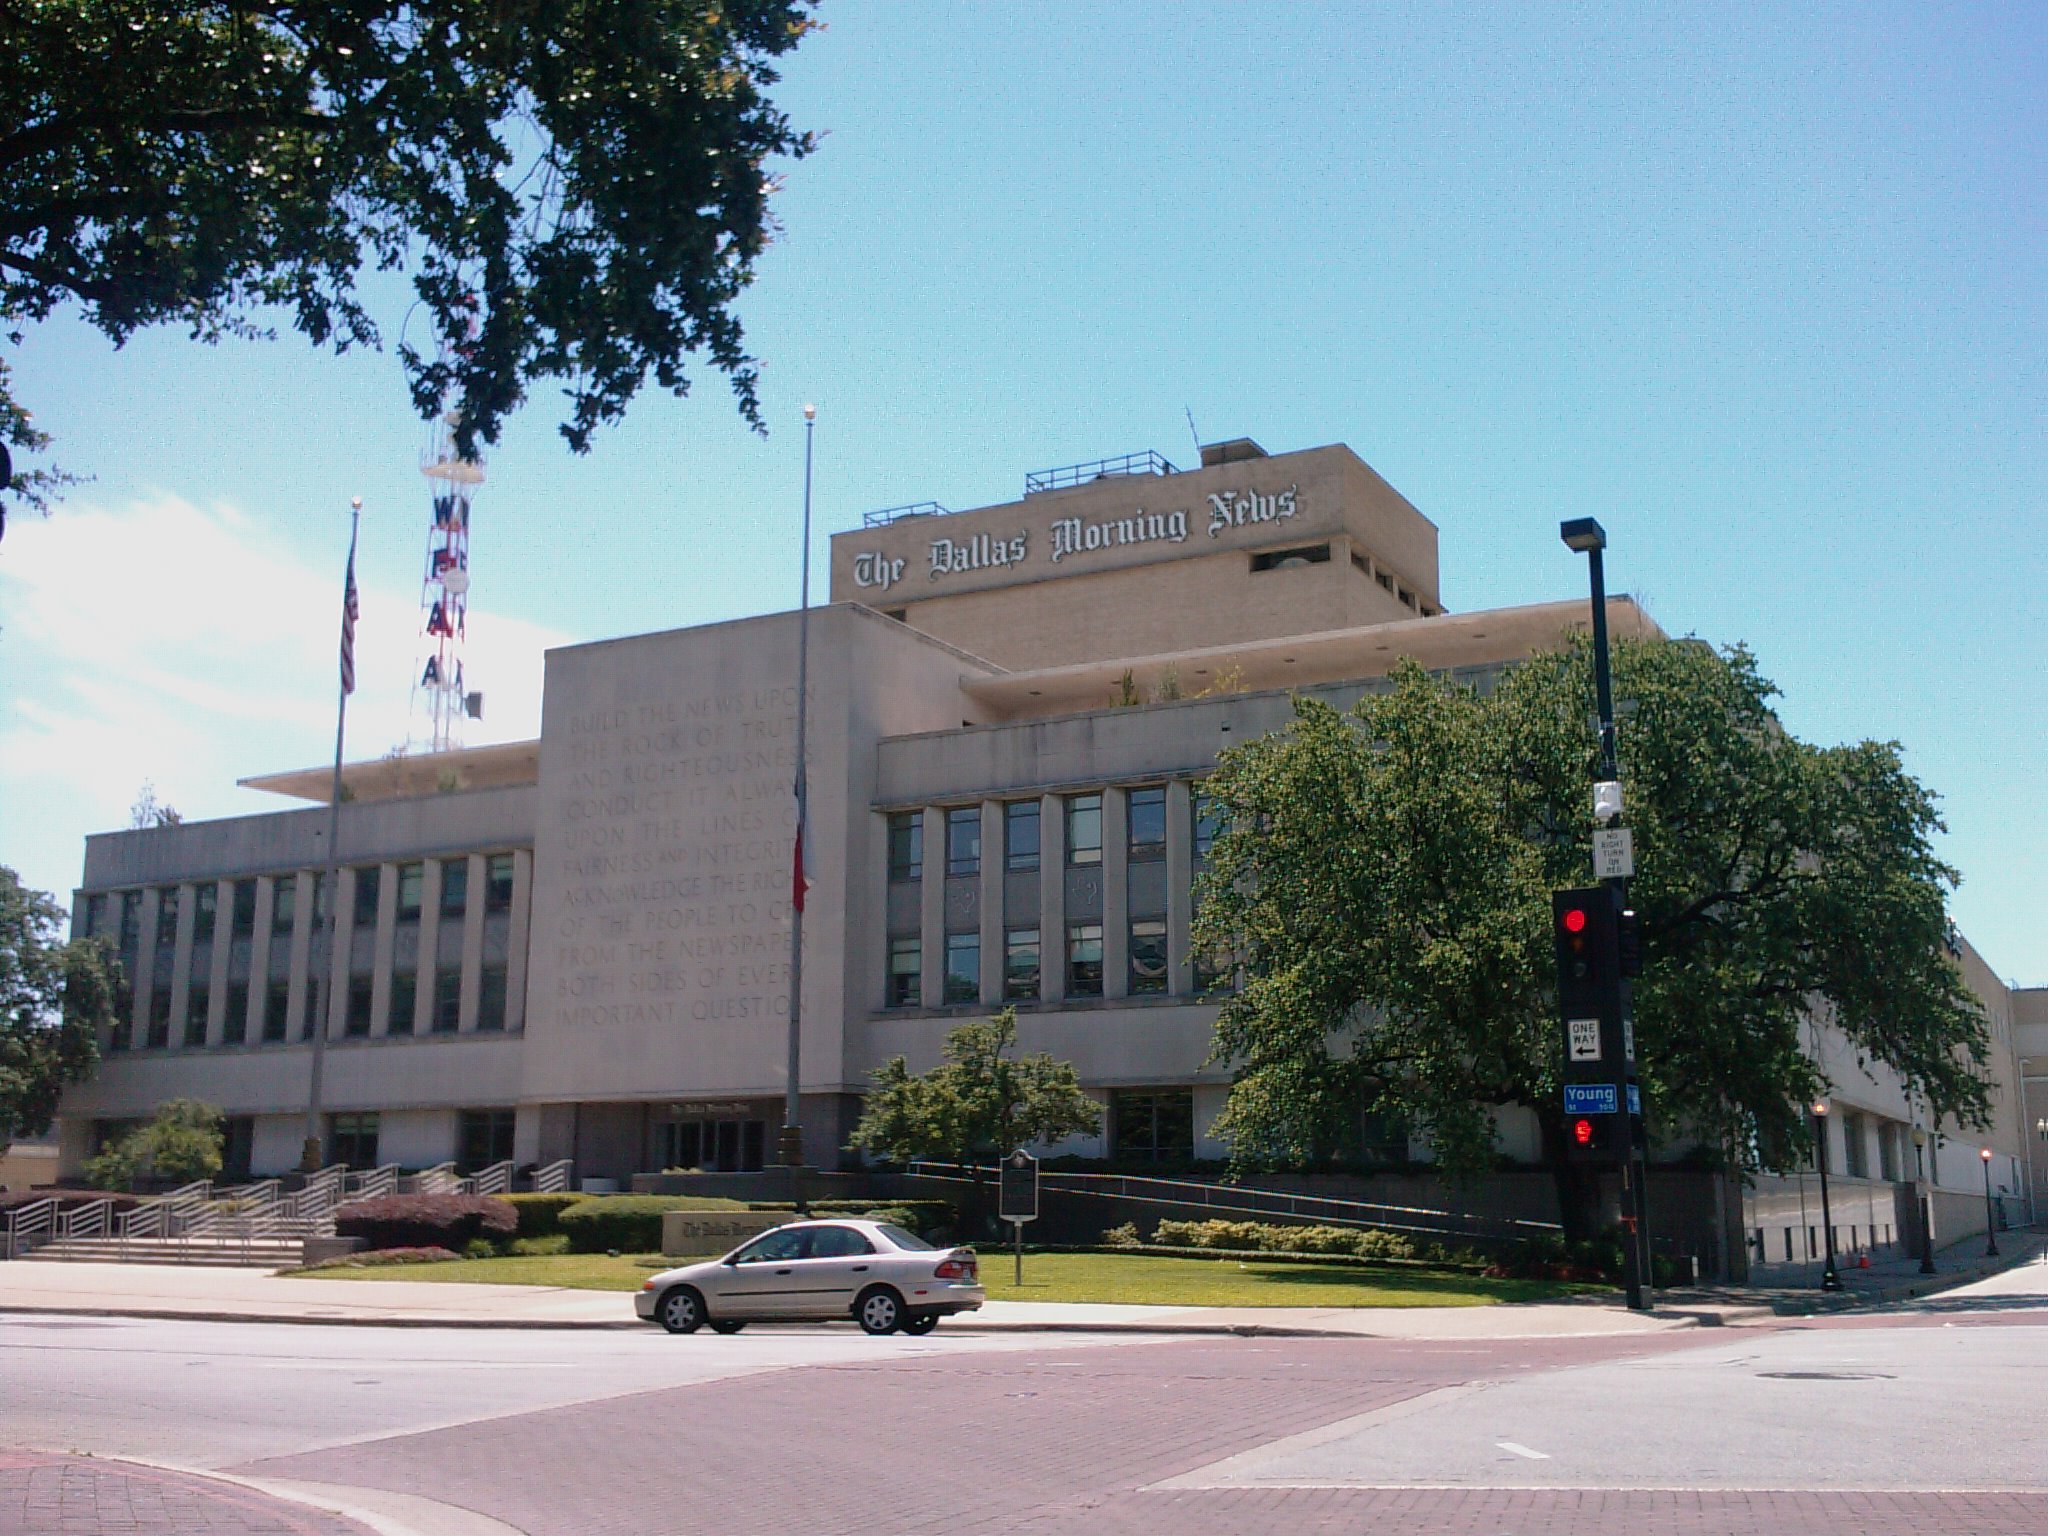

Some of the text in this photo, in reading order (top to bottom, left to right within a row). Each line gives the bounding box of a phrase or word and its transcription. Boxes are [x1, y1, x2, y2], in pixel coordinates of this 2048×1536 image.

[854, 484, 1298, 592] The Dallas Morning News
[638, 702, 676, 724] THE
[570, 740, 608, 762] THE
[695, 724, 726, 747] OF
[641, 819, 682, 842] THE
[700, 811, 764, 836] LINES
[709, 872, 745, 895] THE
[645, 905, 718, 932] PEOPLE
[728, 902, 757, 925] TO
[627, 940, 666, 962] THE
[628, 969, 688, 993] SIDES
[698, 967, 727, 990] OF
[1572, 1023, 1595, 1034] ONE
[1574, 1034, 1596, 1045] WAY
[1568, 1088, 1614, 1103] Young
